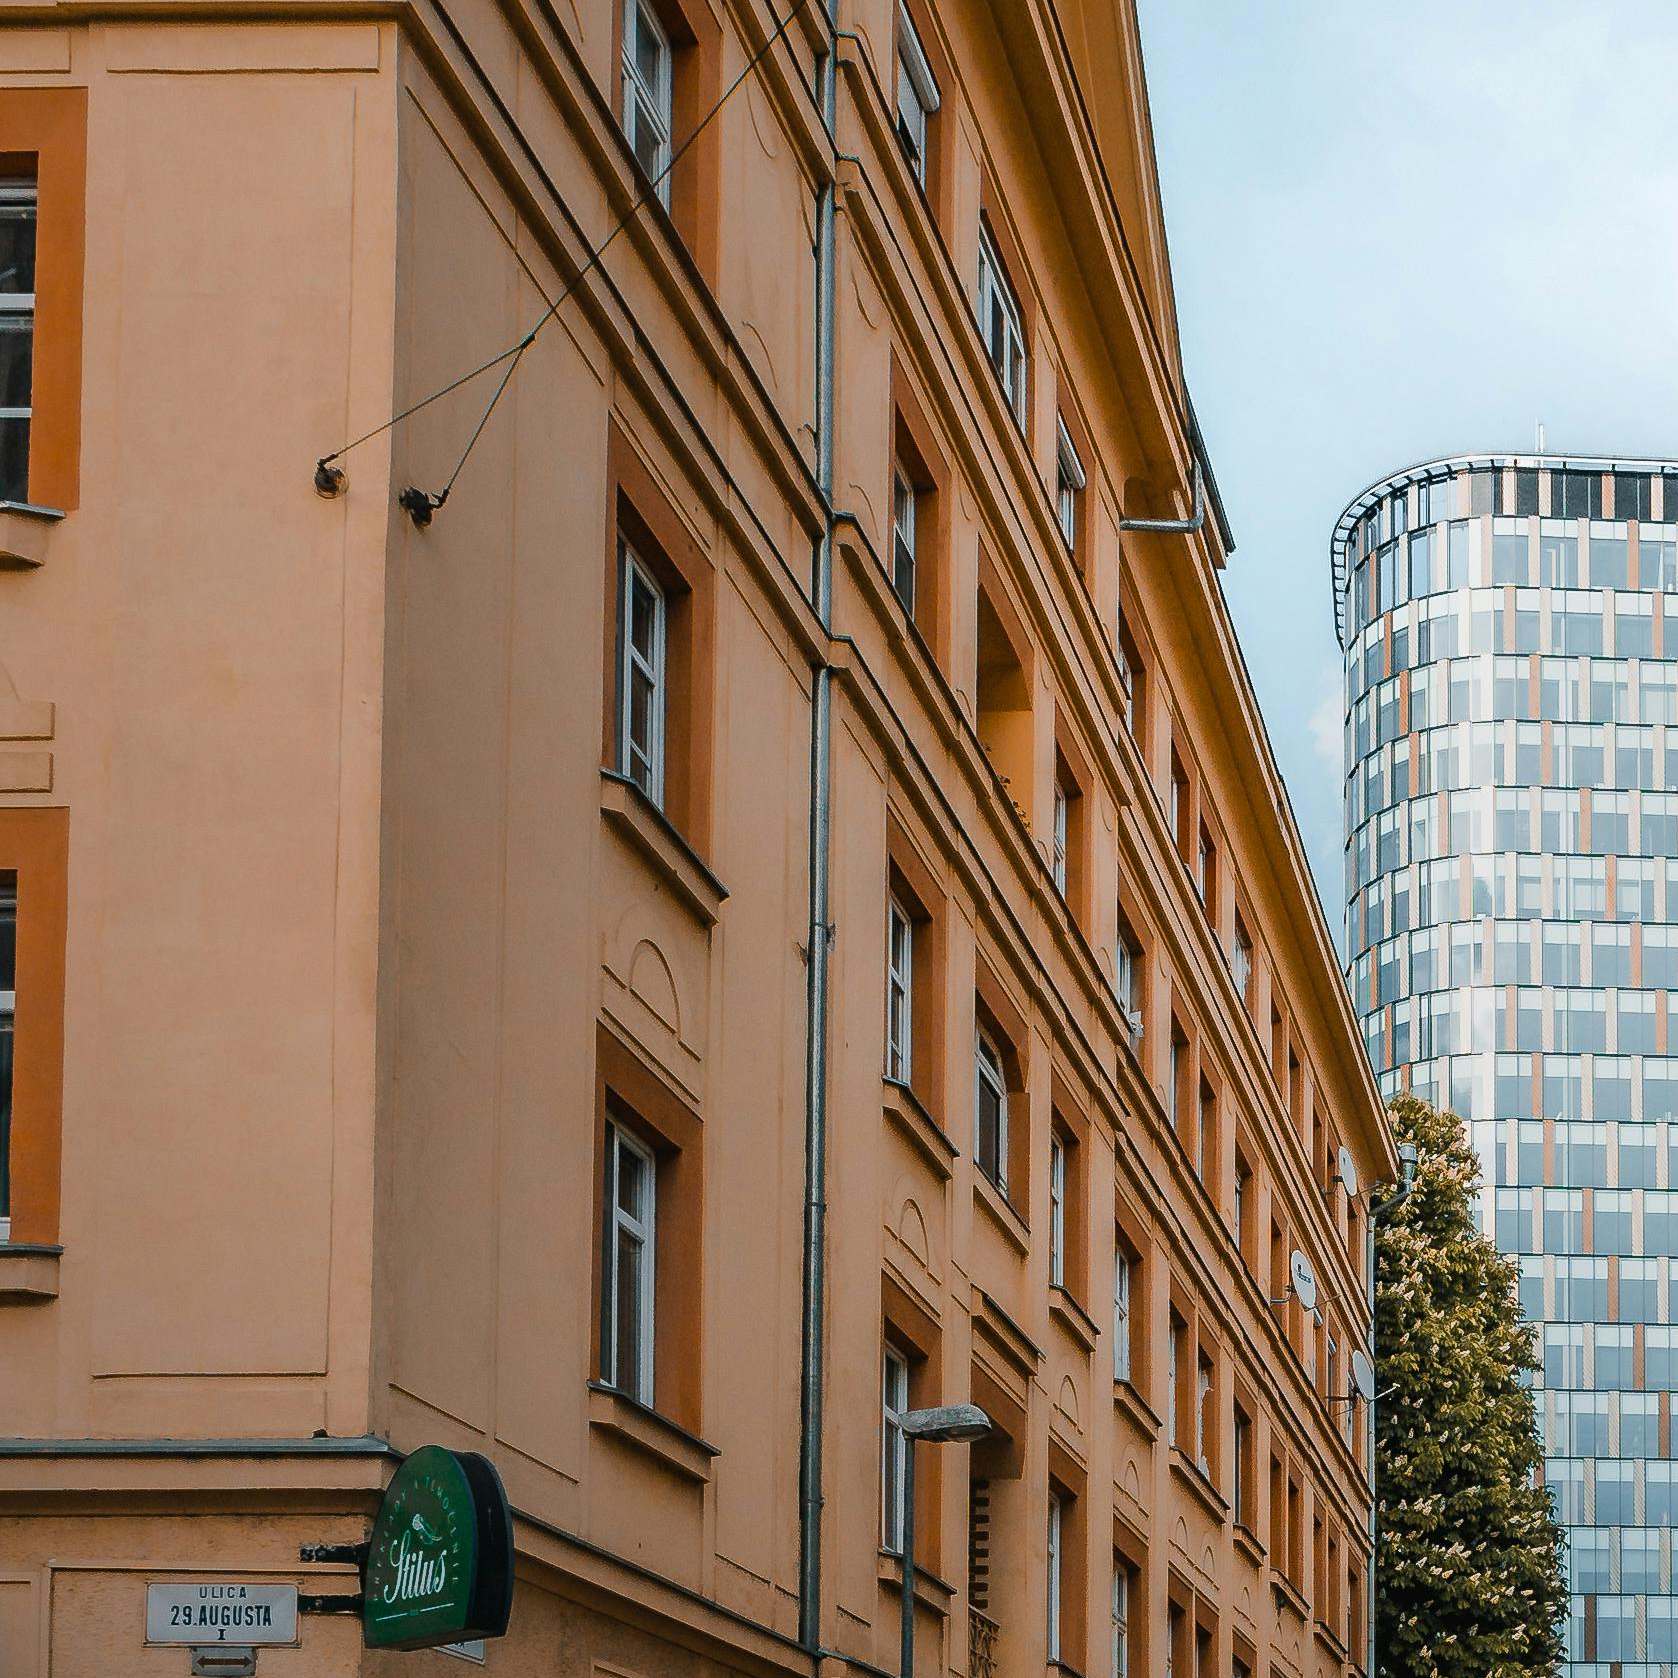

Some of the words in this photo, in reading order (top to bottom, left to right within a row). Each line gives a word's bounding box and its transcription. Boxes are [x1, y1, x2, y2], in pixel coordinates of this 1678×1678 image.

[384, 1530, 448, 1604] Stilus
[199, 1586, 247, 1599] ULICA
[170, 1604, 272, 1626] 29.AUGUSTA
